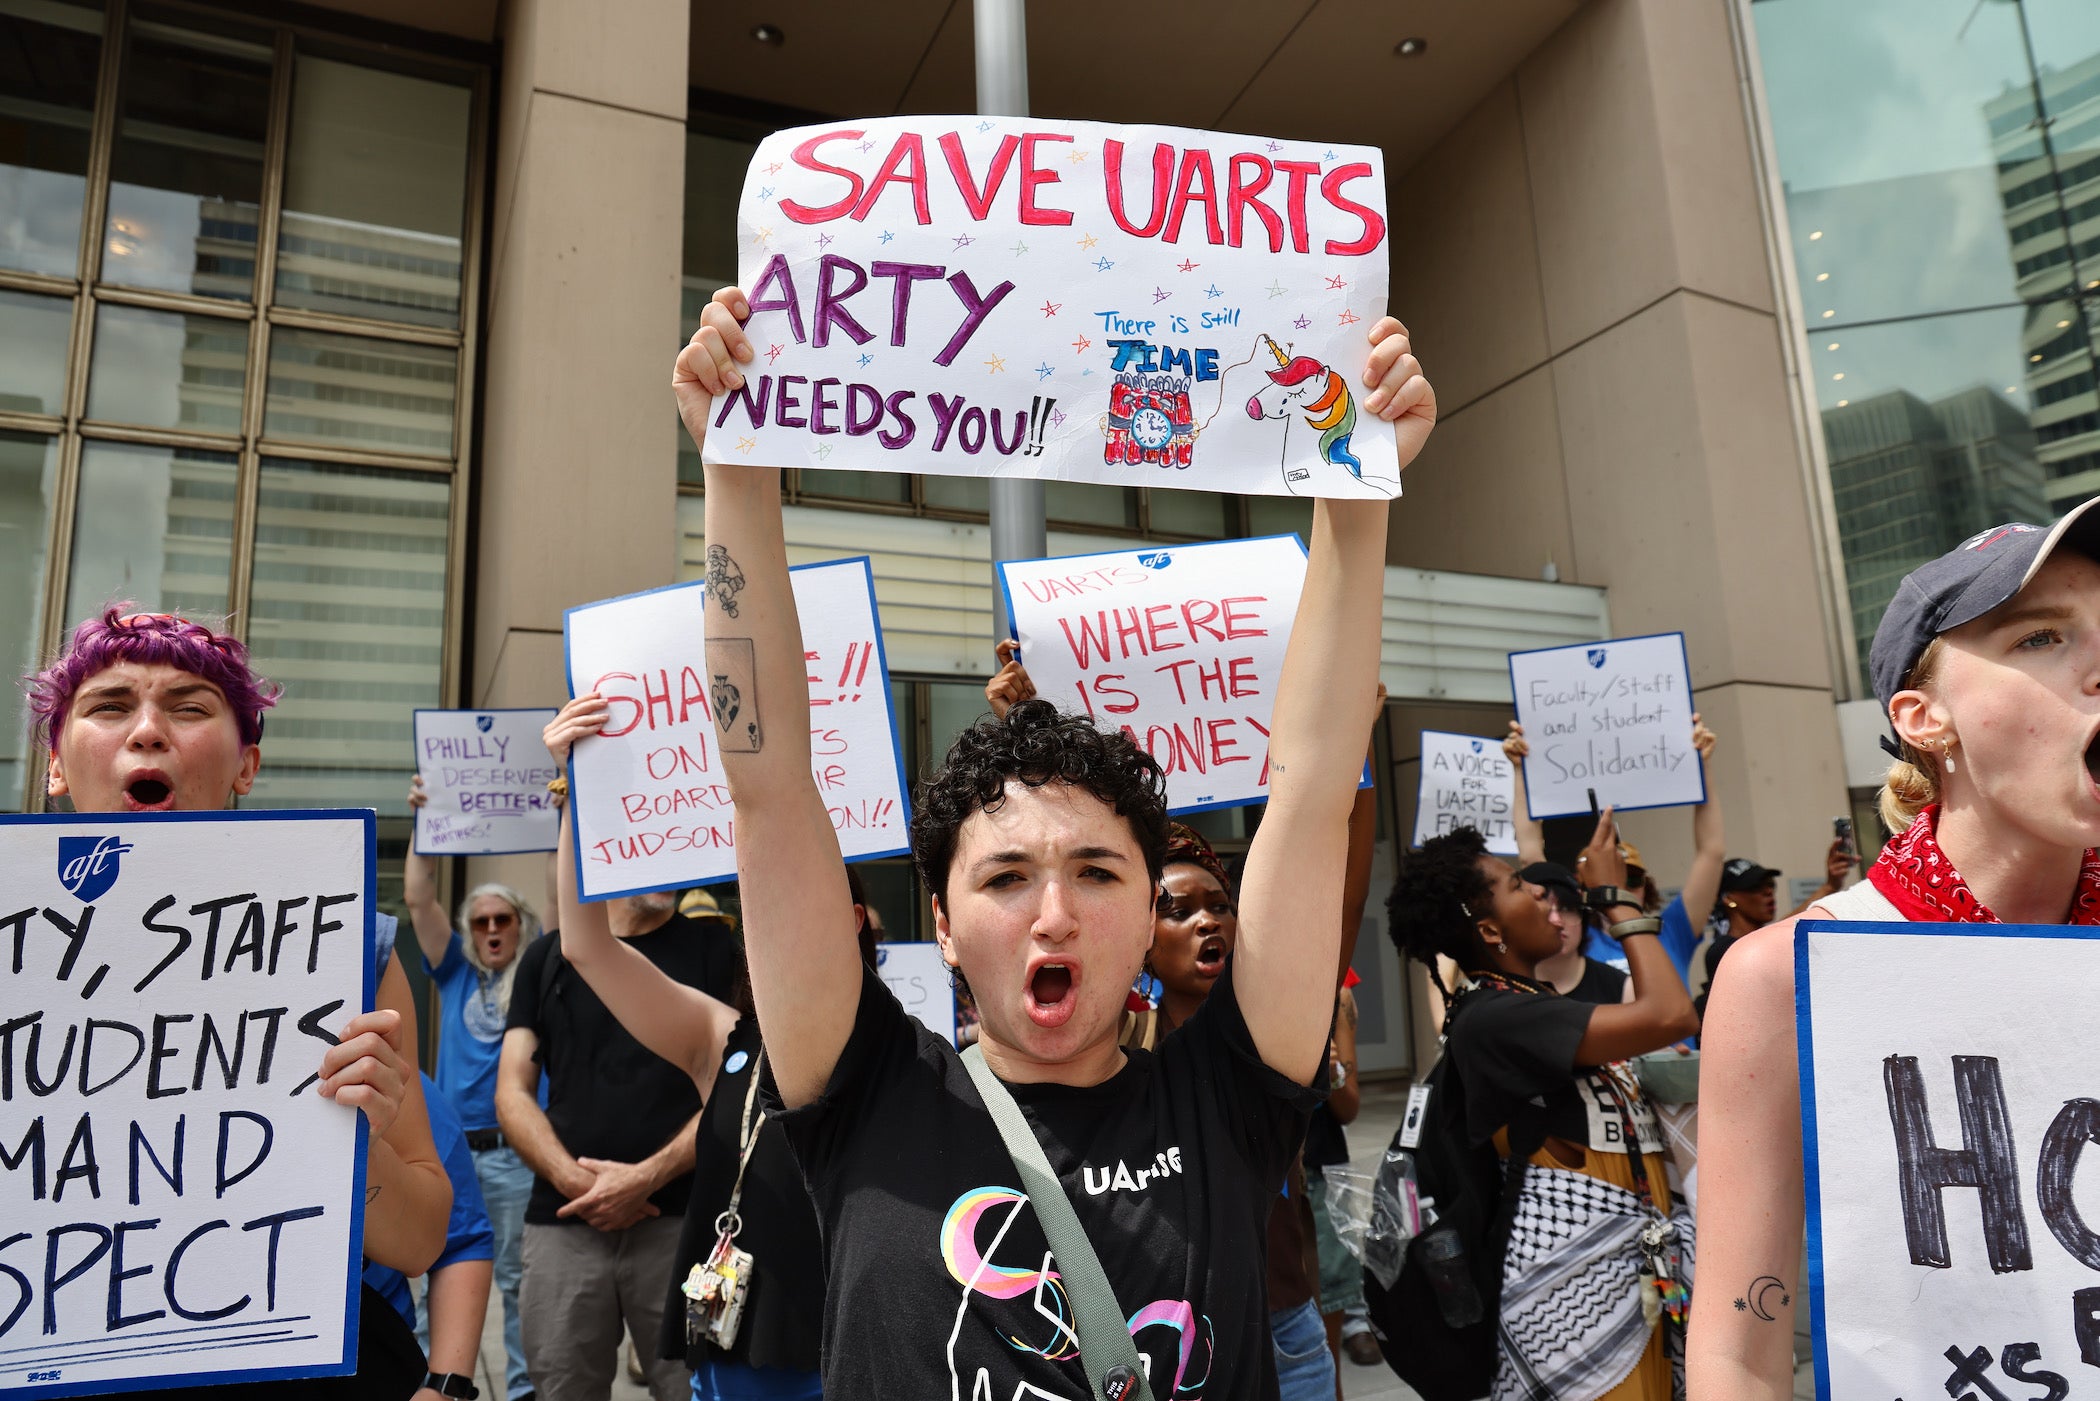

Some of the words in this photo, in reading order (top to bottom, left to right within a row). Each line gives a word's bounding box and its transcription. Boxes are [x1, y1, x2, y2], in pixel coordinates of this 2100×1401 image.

[777, 130, 1075, 226] SAVE
[1103, 138, 1386, 256] UARTS
[742, 253, 1016, 367] ARTY
[1093, 310, 1156, 336] There
[1170, 314, 1190, 334] is
[1106, 339, 1220, 382] TIME
[715, 374, 916, 450] NEEDS
[927, 391, 1057, 457] YOU!!
[1022, 567, 1149, 604] UARTS
[1058, 596, 1268, 670] WHERE
[593, 641, 872, 738] SHAE!!
[1076, 674, 1139, 721] IS
[1155, 656, 1260, 705] THE
[1543, 712, 1577, 736] and
[425, 736, 510, 763] PHILLY
[647, 732, 708, 780] ON
[1120, 716, 1270, 786] ONEY
[1434, 752, 1449, 770] A
[1453, 753, 1508, 778] VOICE
[1544, 734, 1687, 784] Solidarity
[442, 767, 555, 788] DESERVES
[1462, 778, 1487, 791] FOR
[459, 792, 551, 813] BETTER!
[621, 784, 735, 823] BOARD
[1436, 789, 1508, 813] UARTS
[590, 821, 734, 864] JUDSON
[63, 836, 134, 894] aft
[134, 893, 358, 993] STAFF
[1107, 1381, 1118, 1395] THIS
